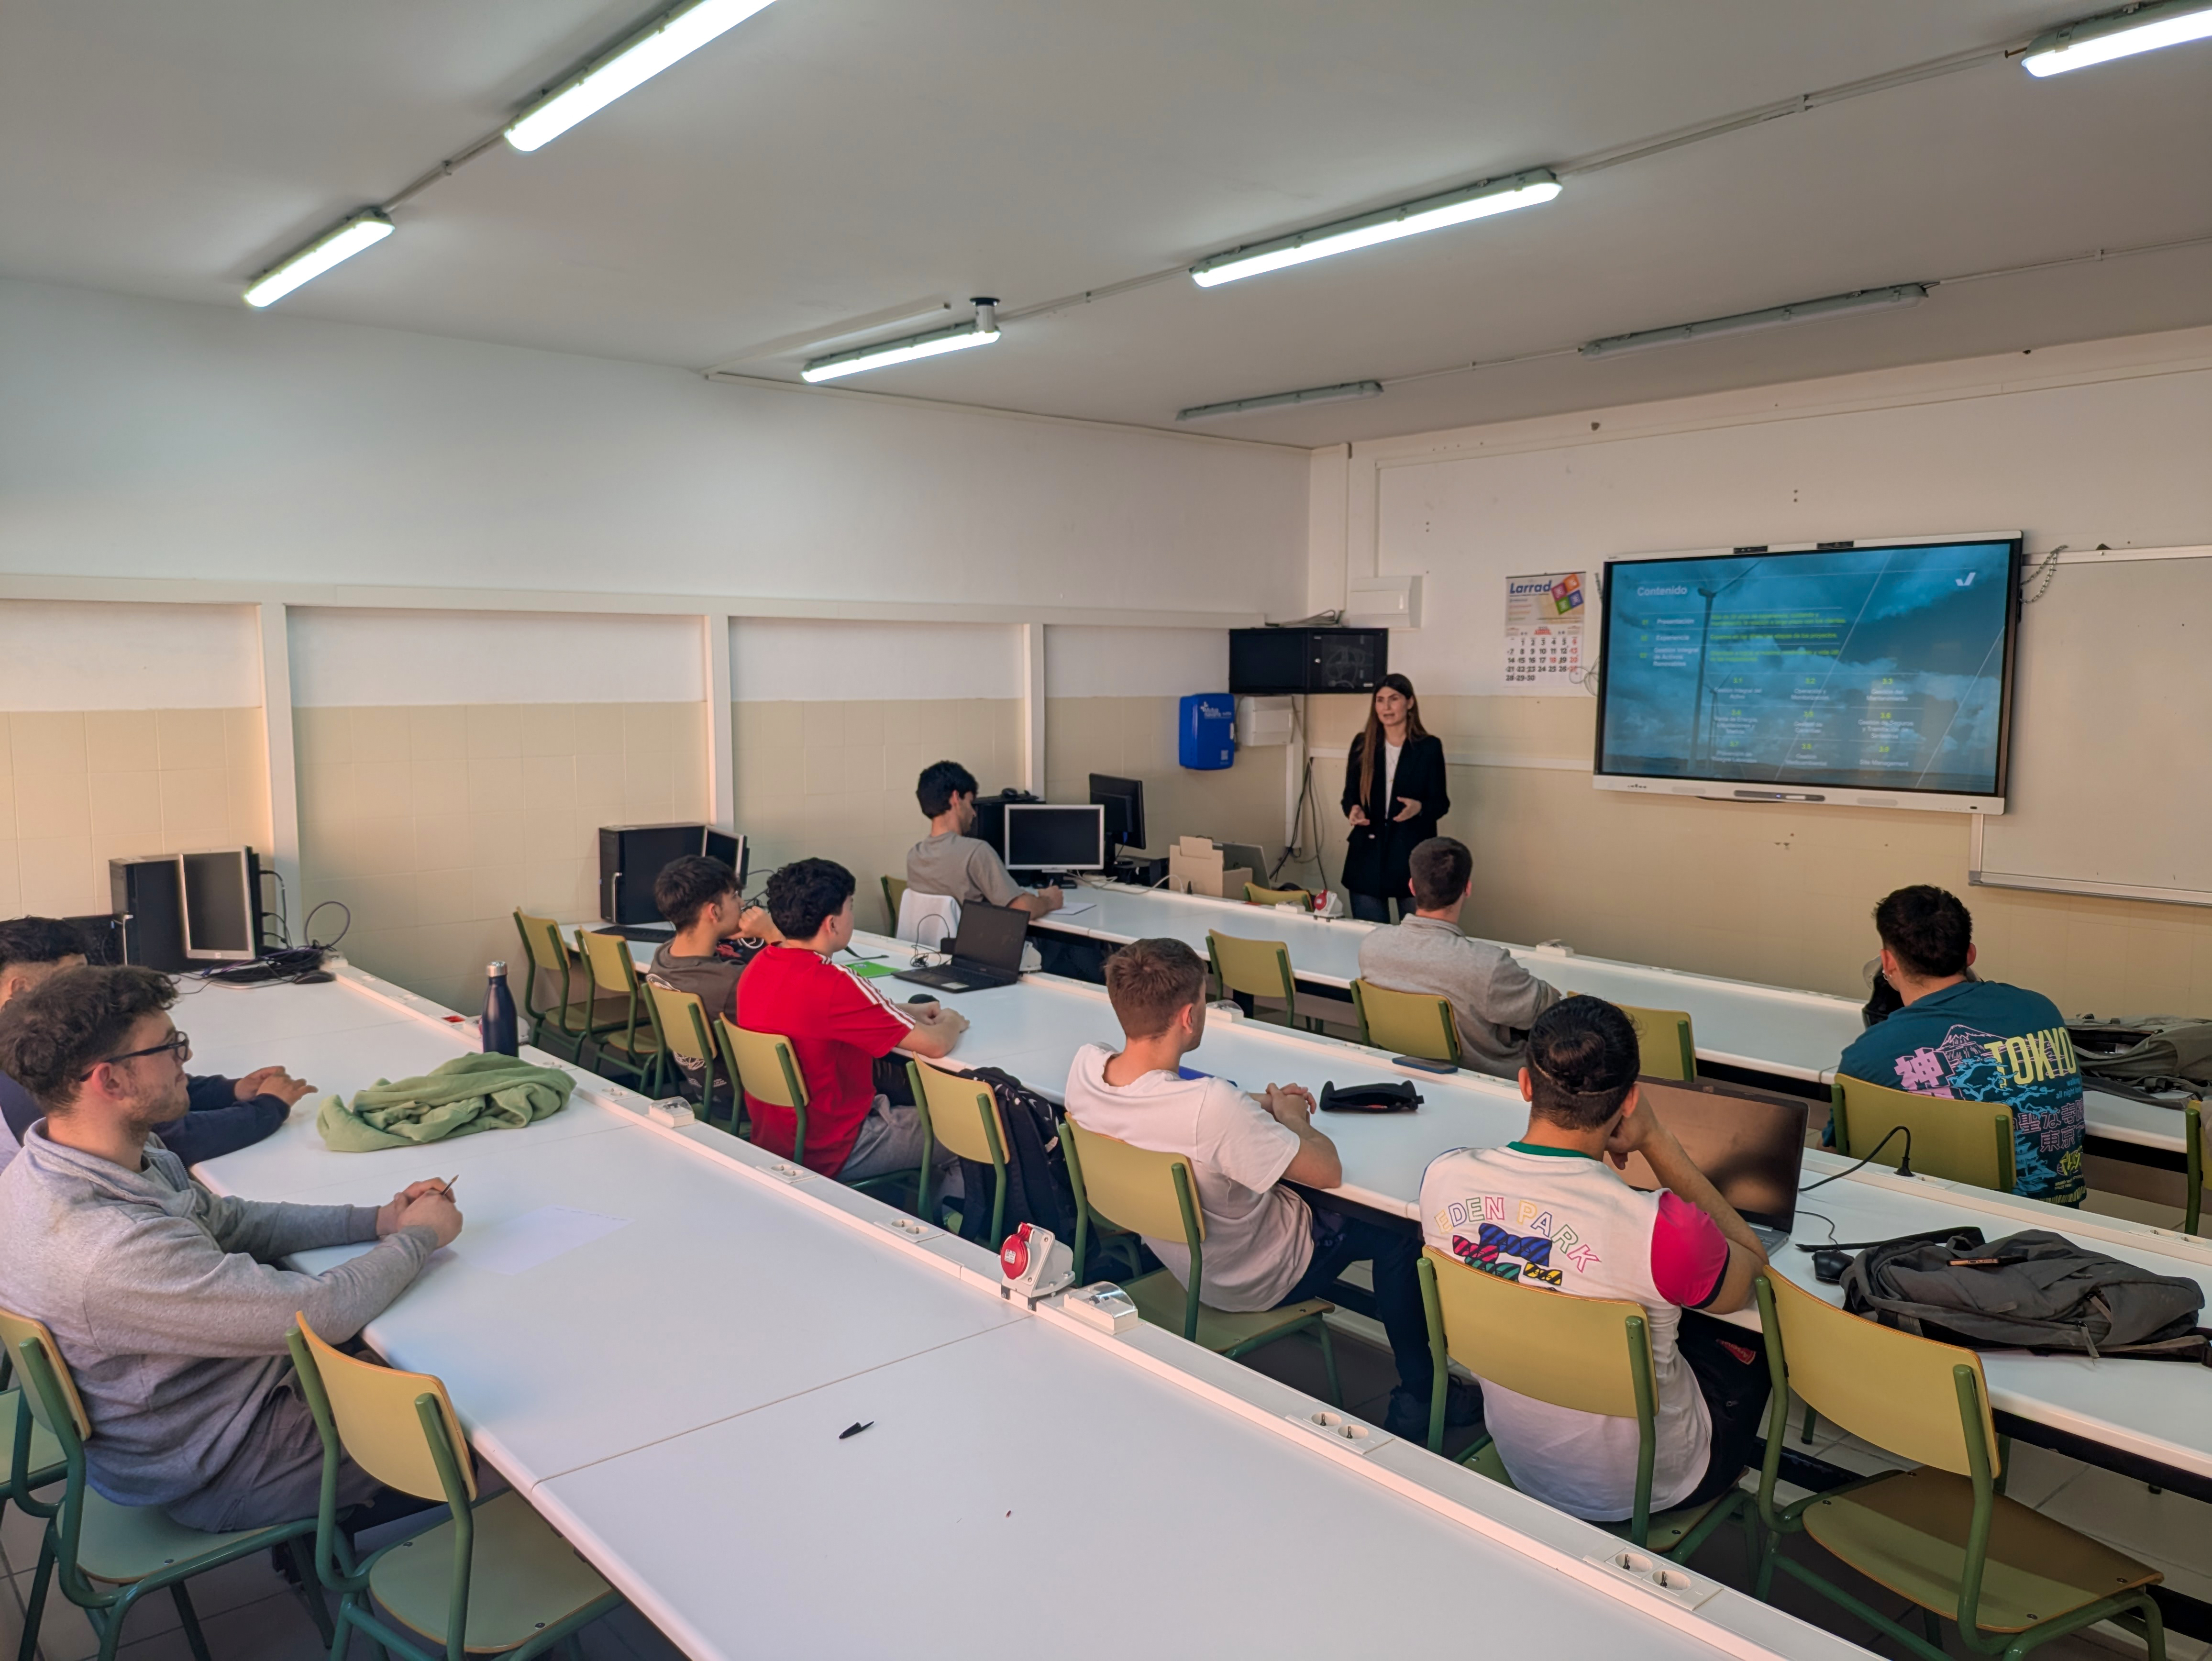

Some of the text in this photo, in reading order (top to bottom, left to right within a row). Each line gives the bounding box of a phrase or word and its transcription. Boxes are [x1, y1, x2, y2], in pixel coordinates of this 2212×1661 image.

[1509, 580, 1552, 594] Larrad
[1637, 585, 1688, 597] Contenido
[1871, 759, 1909, 767] Management
[1984, 1027, 2077, 1088] TOKYO
[1434, 1196, 1600, 1273] EDEN PARK
